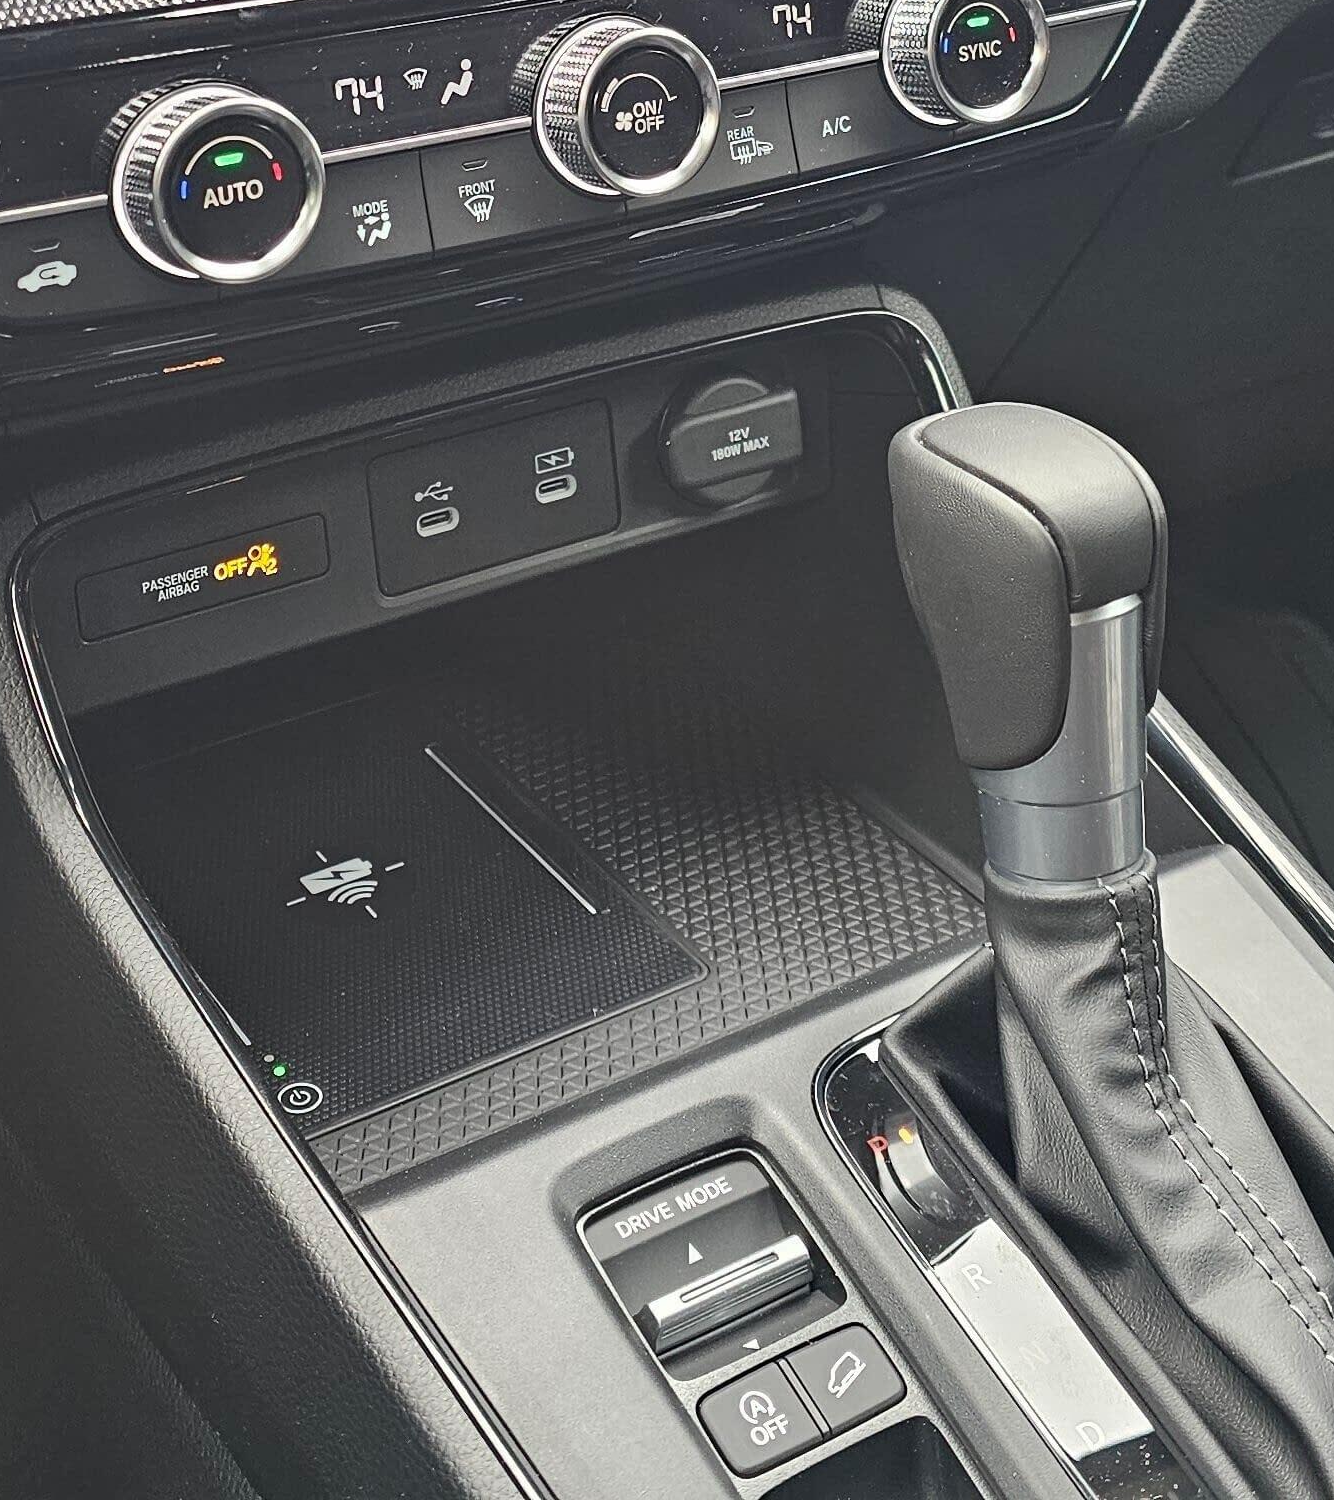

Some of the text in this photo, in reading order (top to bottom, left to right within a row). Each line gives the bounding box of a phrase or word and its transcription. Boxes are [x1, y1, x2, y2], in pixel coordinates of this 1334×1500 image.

[771, 2, 813, 39] 74
[958, 39, 1003, 63] SYNC
[335, 75, 385, 116] 74
[632, 99, 664, 118] ON/
[633, 114, 666, 134] OFF
[727, 125, 754, 141] REAR
[821, 115, 853, 139] A/C
[203, 179, 264, 209] AUTO
[458, 179, 496, 199] FRONT
[352, 200, 389, 217] MODE
[728, 426, 750, 442] 12V
[710, 436, 770, 461] 180W MAX
[141, 565, 209, 594] PASSENGER
[213, 556, 248, 582] OFF
[157, 580, 201, 602] AIRBAG
[614, 1176, 733, 1239] DRIVE MODE
[961, 1261, 993, 1292] R
[749, 1413, 789, 1446] OFF
[1075, 1420, 1107, 1450] D
